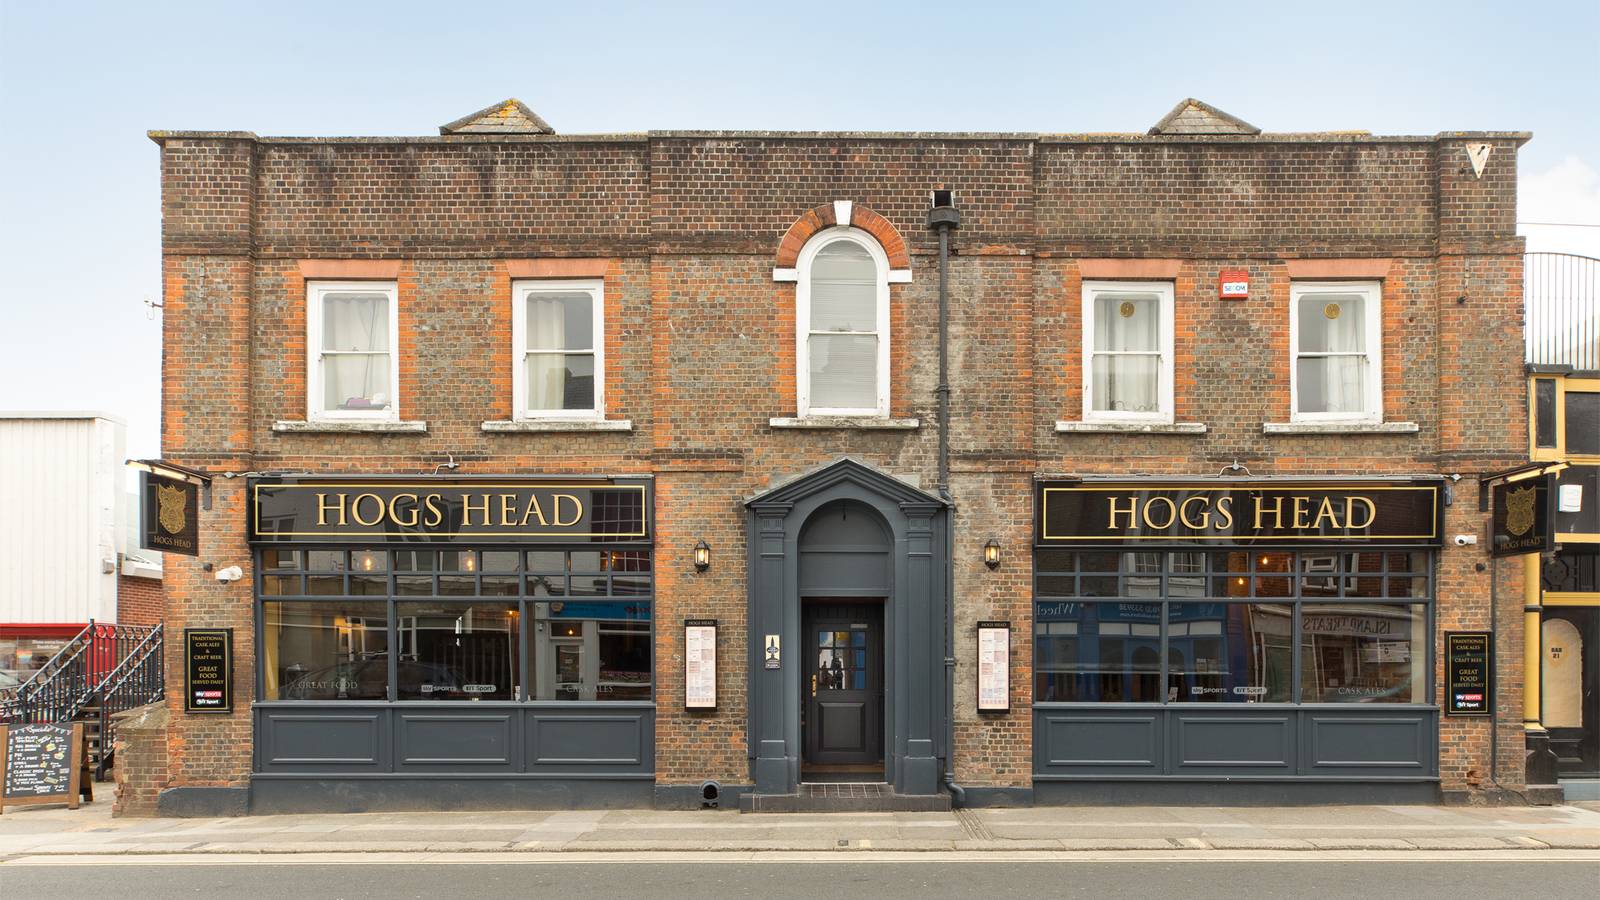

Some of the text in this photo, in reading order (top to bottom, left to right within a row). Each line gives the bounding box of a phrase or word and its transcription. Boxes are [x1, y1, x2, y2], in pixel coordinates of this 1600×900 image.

[316, 493, 584, 526] HOGS HEAD
[1107, 496, 1377, 530] HOGS HEAD
[154, 536, 191, 548] HOGS HEAD
[1501, 537, 1540, 550] HOGS HEAD
[298, 680, 327, 689] GREAT
